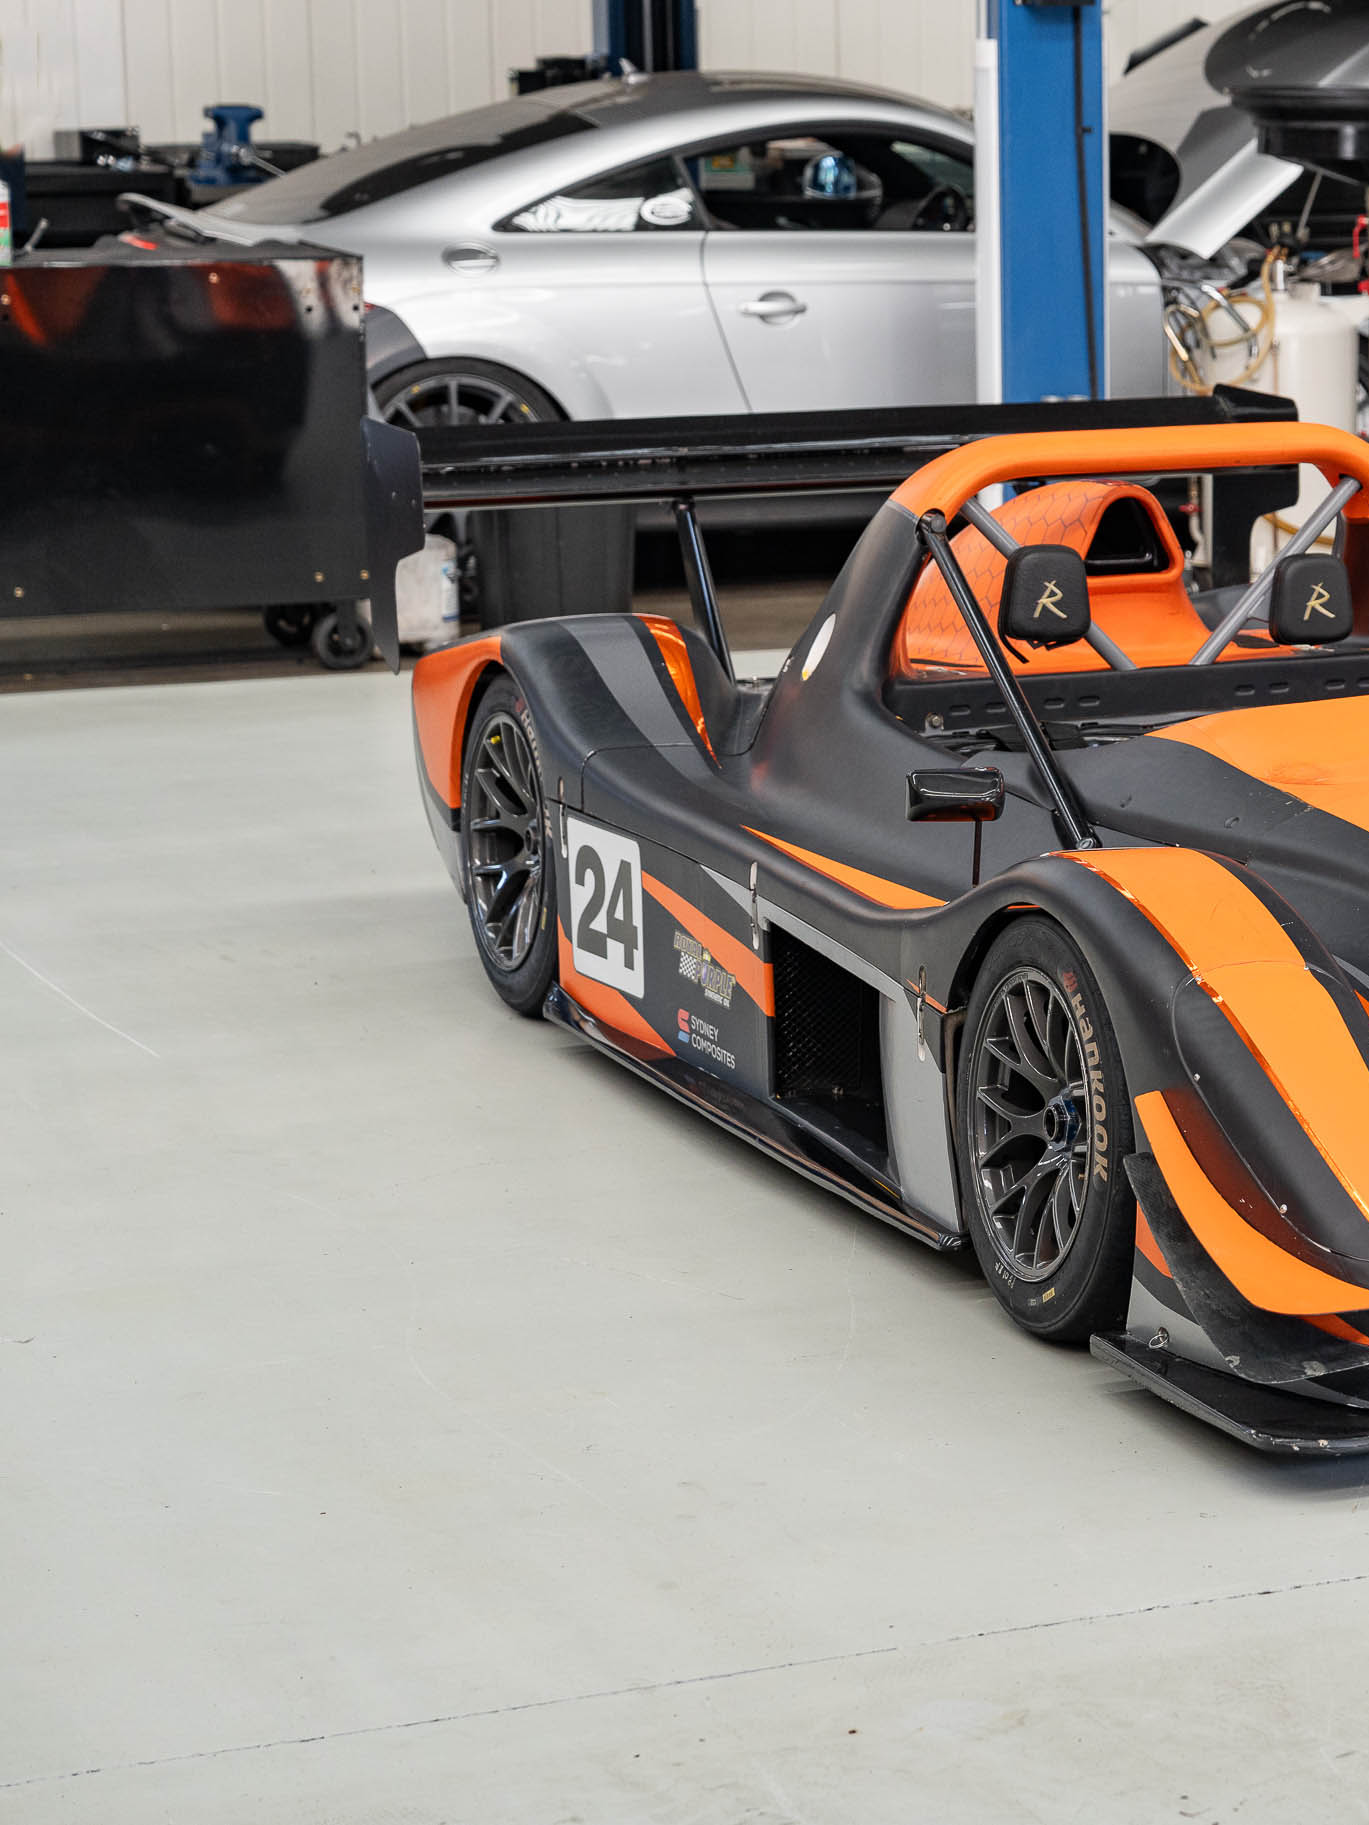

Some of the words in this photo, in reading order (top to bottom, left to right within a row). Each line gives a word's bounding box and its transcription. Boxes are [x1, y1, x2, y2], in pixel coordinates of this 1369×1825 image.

[1032, 580, 1068, 619] R
[1303, 582, 1336, 621] R
[574, 843, 639, 972] 24
[690, 1015, 719, 1042] SYDNEY
[691, 1033, 736, 1070] COMPOSITES
